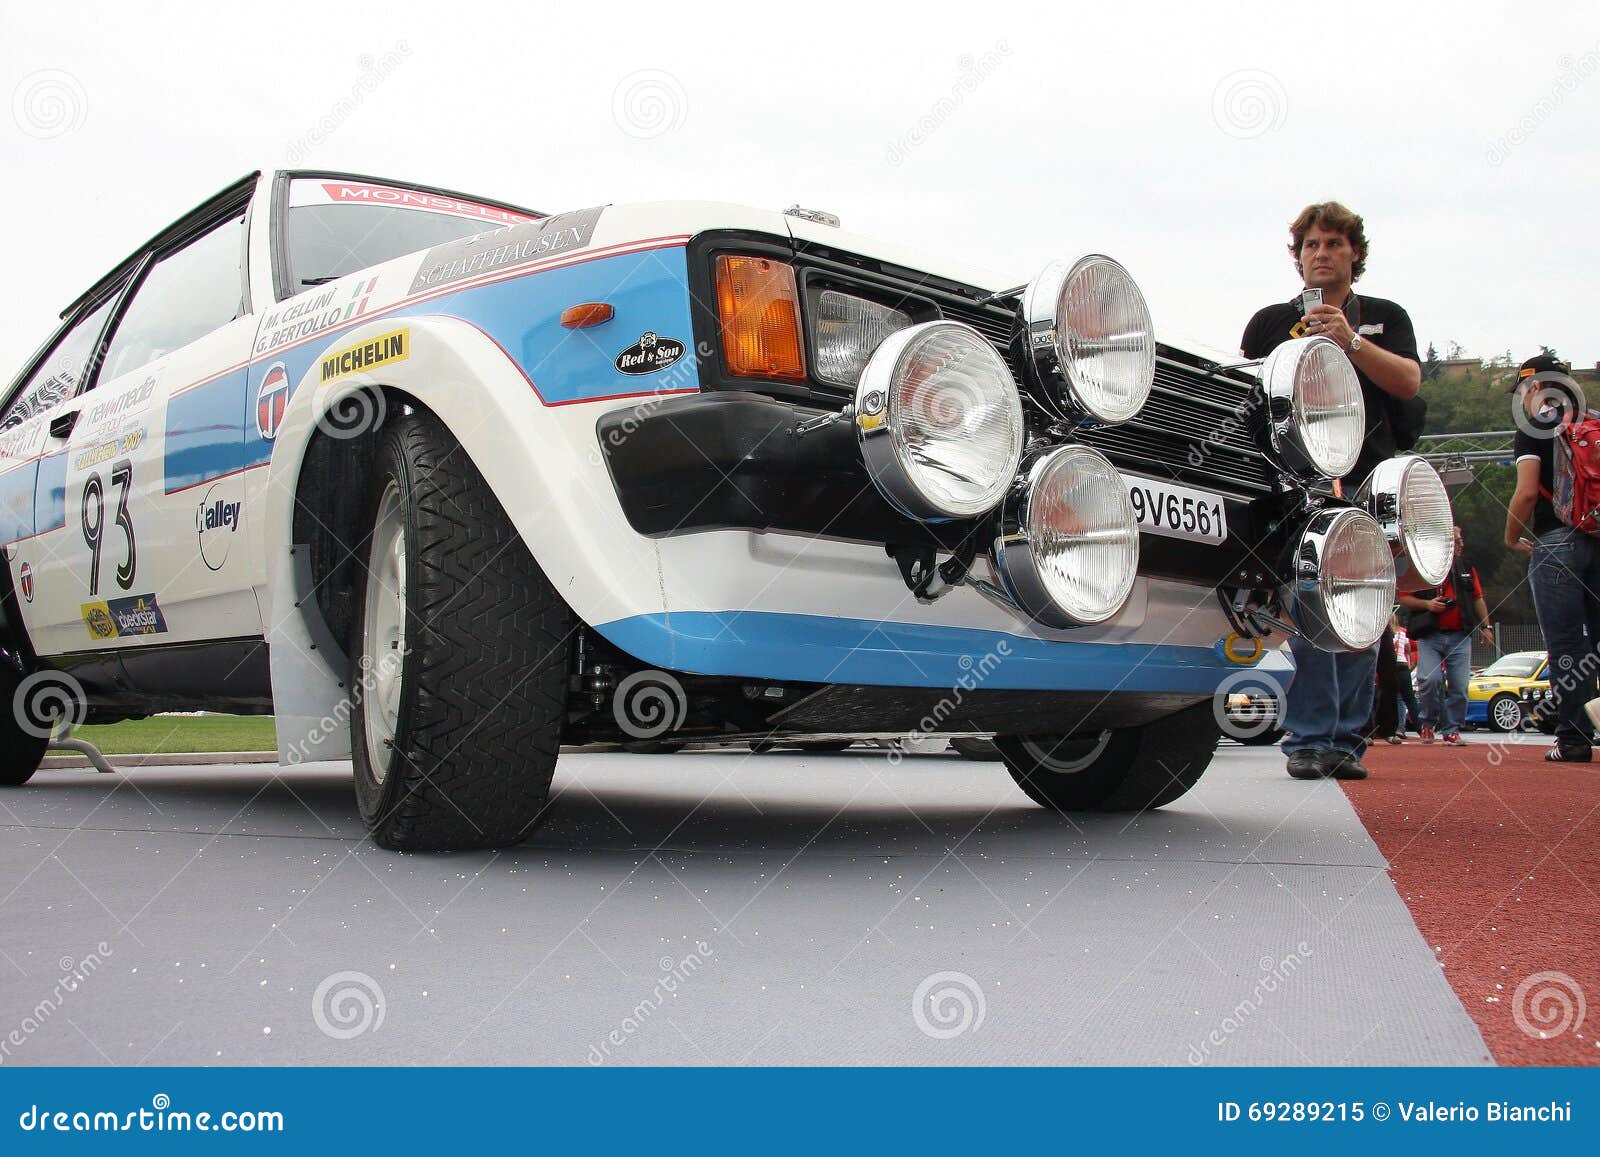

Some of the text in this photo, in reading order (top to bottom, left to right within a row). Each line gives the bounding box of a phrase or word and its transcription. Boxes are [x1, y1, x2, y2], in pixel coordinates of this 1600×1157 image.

[416, 224, 588, 288] SCHAFFHAUSEN
[264, 288, 338, 330] M. CELLINI
[271, 308, 341, 348] BERTOLLO
[322, 334, 403, 382] MICHELIN
[621, 350, 646, 369] Red
[647, 352, 655, 363] &
[657, 345, 679, 359] Son
[82, 458, 137, 596] 93
[1130, 487, 1223, 538] 9V6561
[118, 610, 158, 630] checkstar
